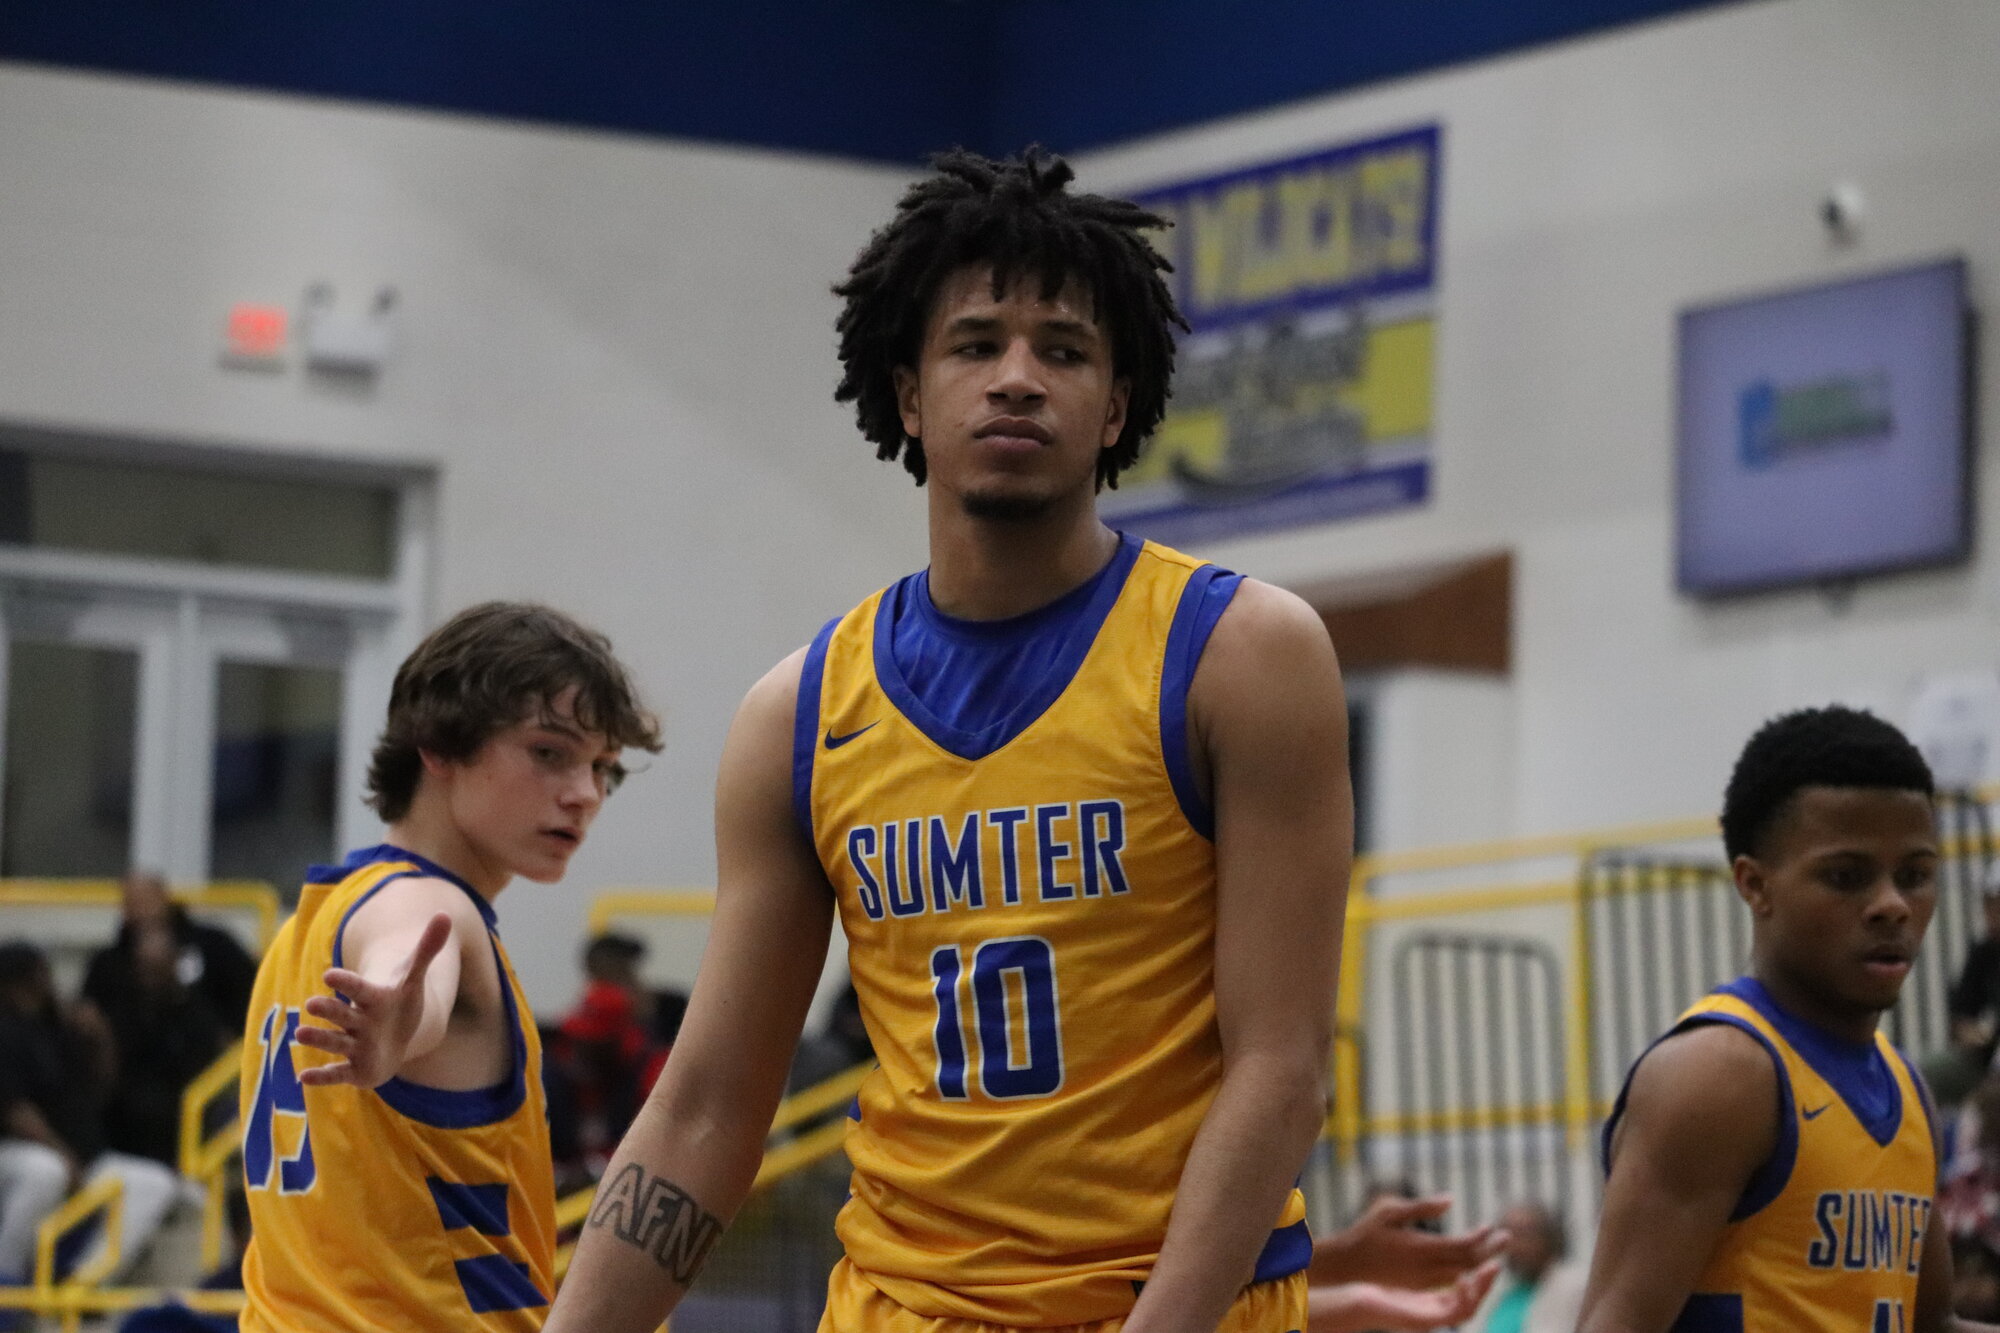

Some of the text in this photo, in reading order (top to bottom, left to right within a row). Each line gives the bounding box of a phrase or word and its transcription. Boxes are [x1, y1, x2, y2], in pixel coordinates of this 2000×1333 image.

[847, 798, 1131, 922] SUMTER
[929, 934, 1066, 1102] 10
[1807, 1189, 1932, 1275] SUMTE
